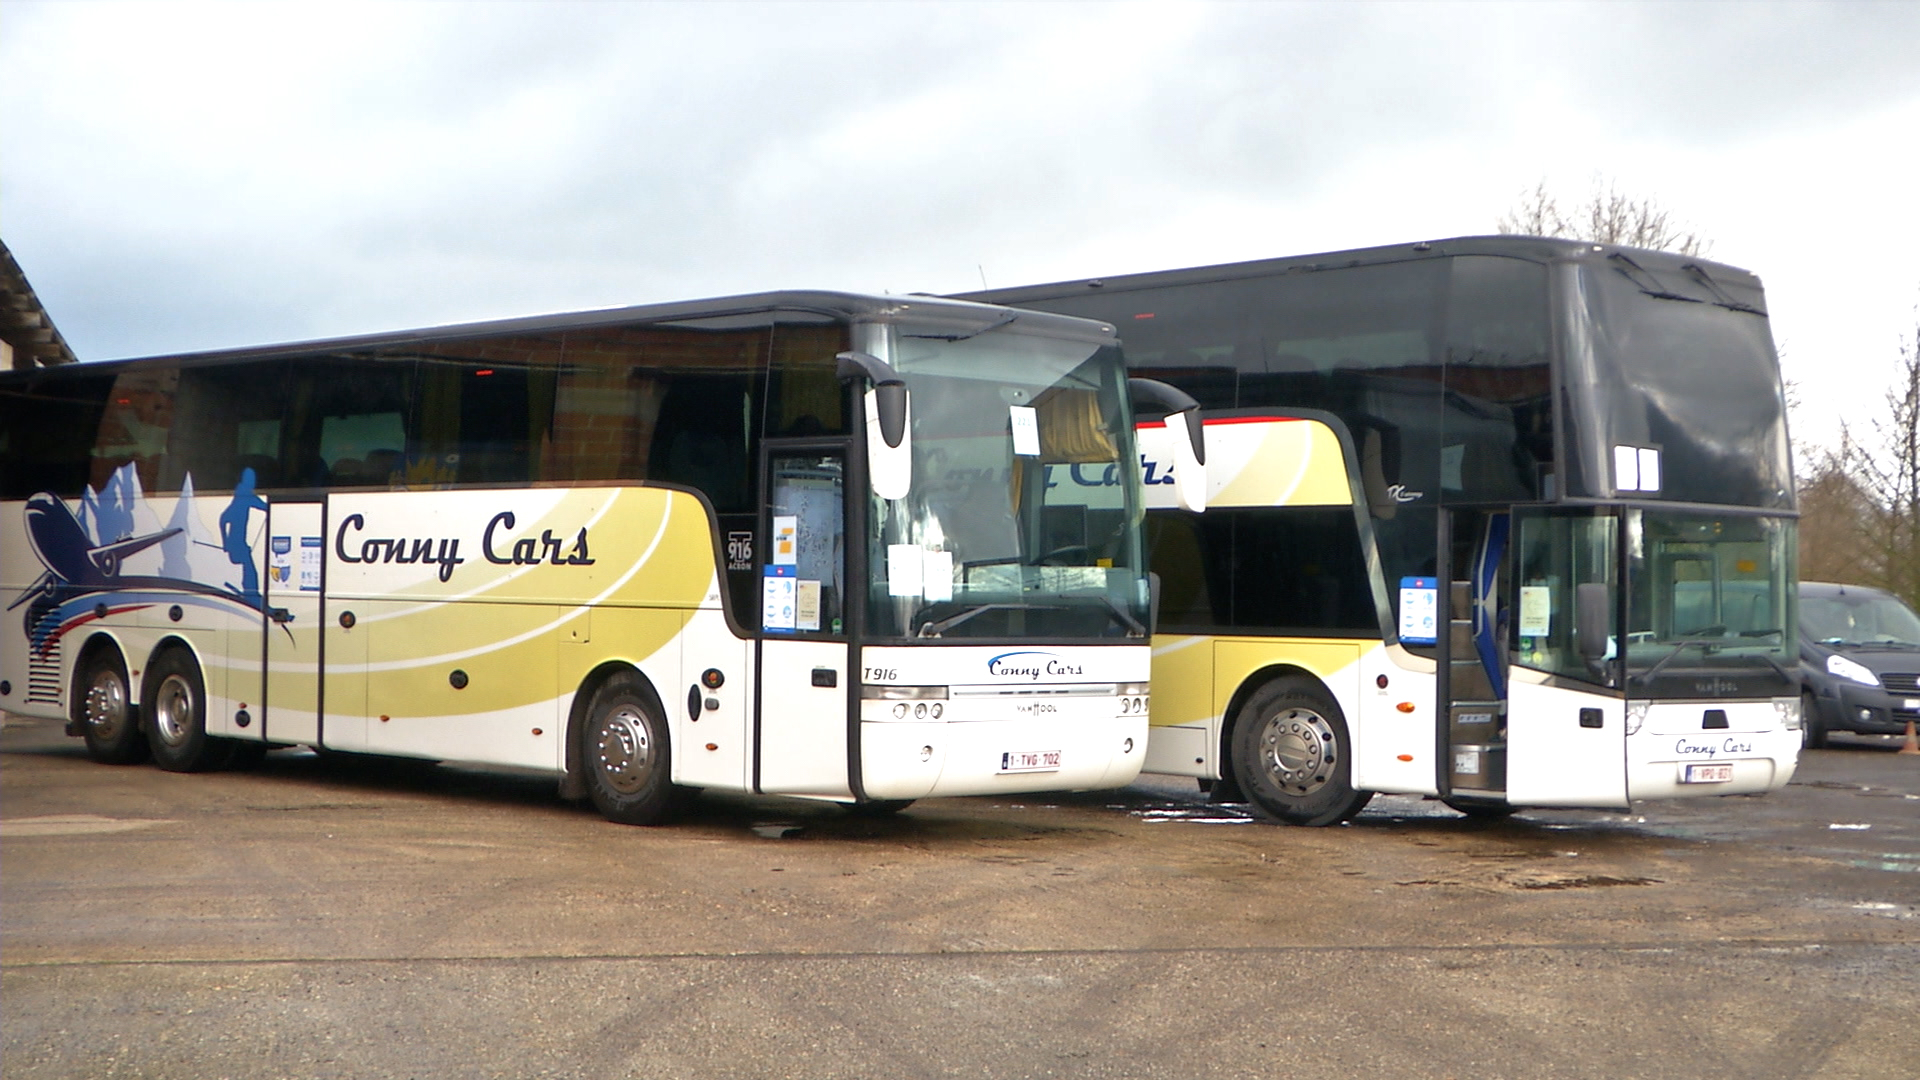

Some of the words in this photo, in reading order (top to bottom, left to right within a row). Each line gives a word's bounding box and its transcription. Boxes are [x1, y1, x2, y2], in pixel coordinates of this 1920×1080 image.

[335, 513, 464, 582] Conny
[482, 511, 595, 565] Cars
[728, 541, 752, 560] 916
[989, 659, 1040, 680] Conny
[1046, 659, 1083, 675] Cars
[1675, 738, 1716, 759] Conny
[1723, 737, 1752, 753] Cars
